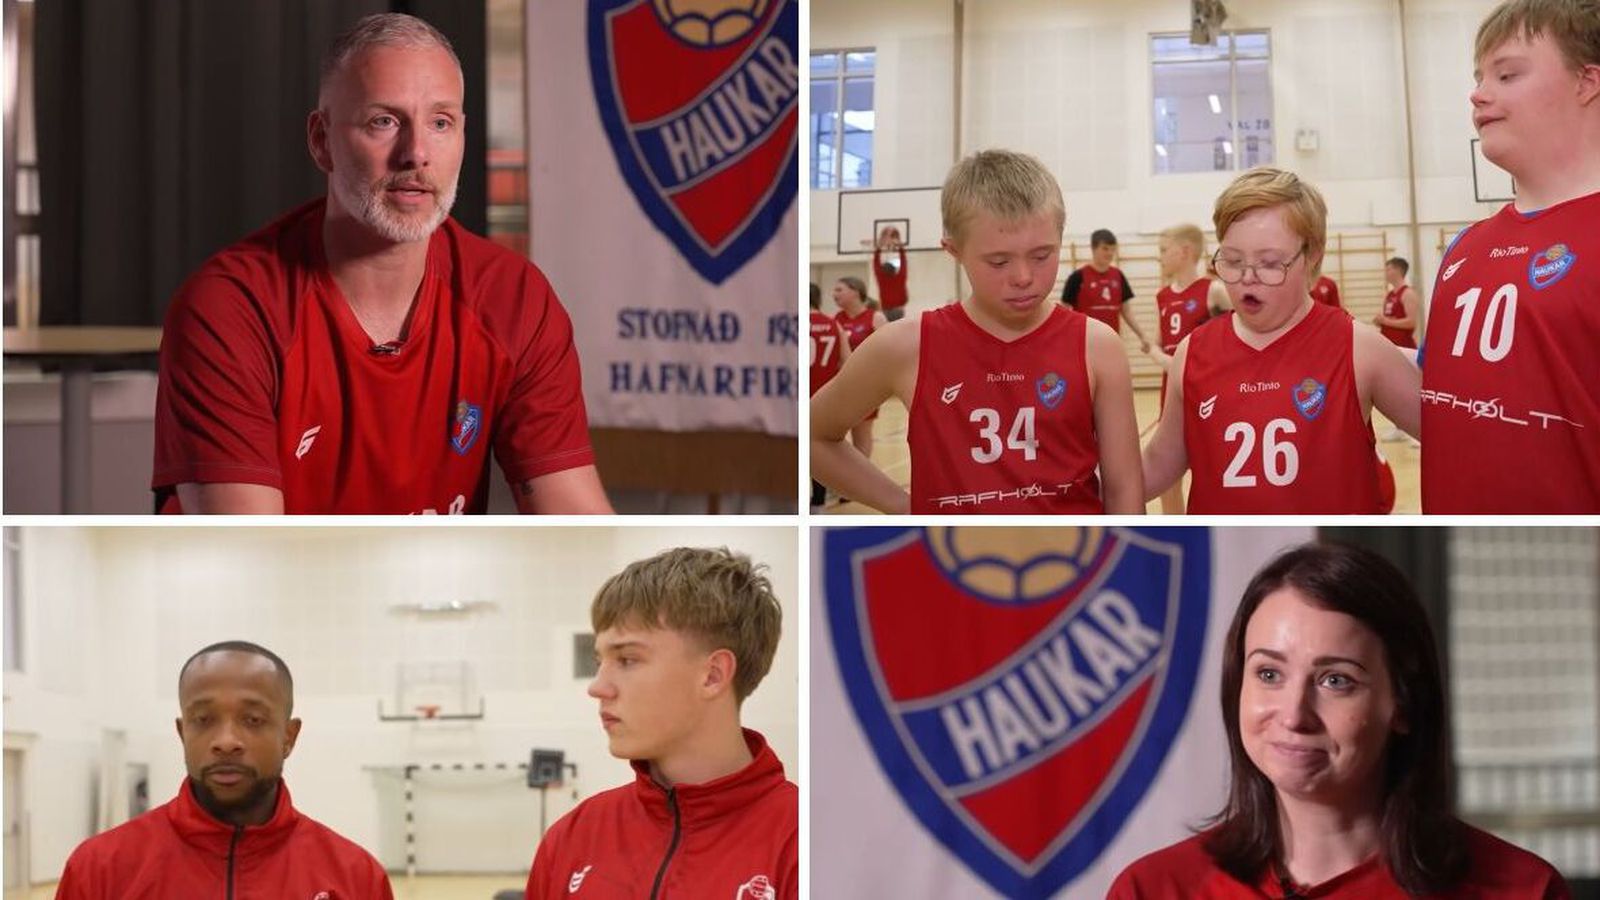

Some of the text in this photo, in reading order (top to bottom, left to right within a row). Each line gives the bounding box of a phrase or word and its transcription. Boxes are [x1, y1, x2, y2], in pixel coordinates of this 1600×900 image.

[660, 36, 798, 182] HAUKAR
[1170, 313, 1181, 336] 9
[1451, 282, 1518, 363] 10
[609, 360, 798, 400] HAFNARFIR
[969, 406, 1040, 465] 34
[1223, 417, 1300, 489] 26
[940, 588, 1162, 780] HAUKAR
